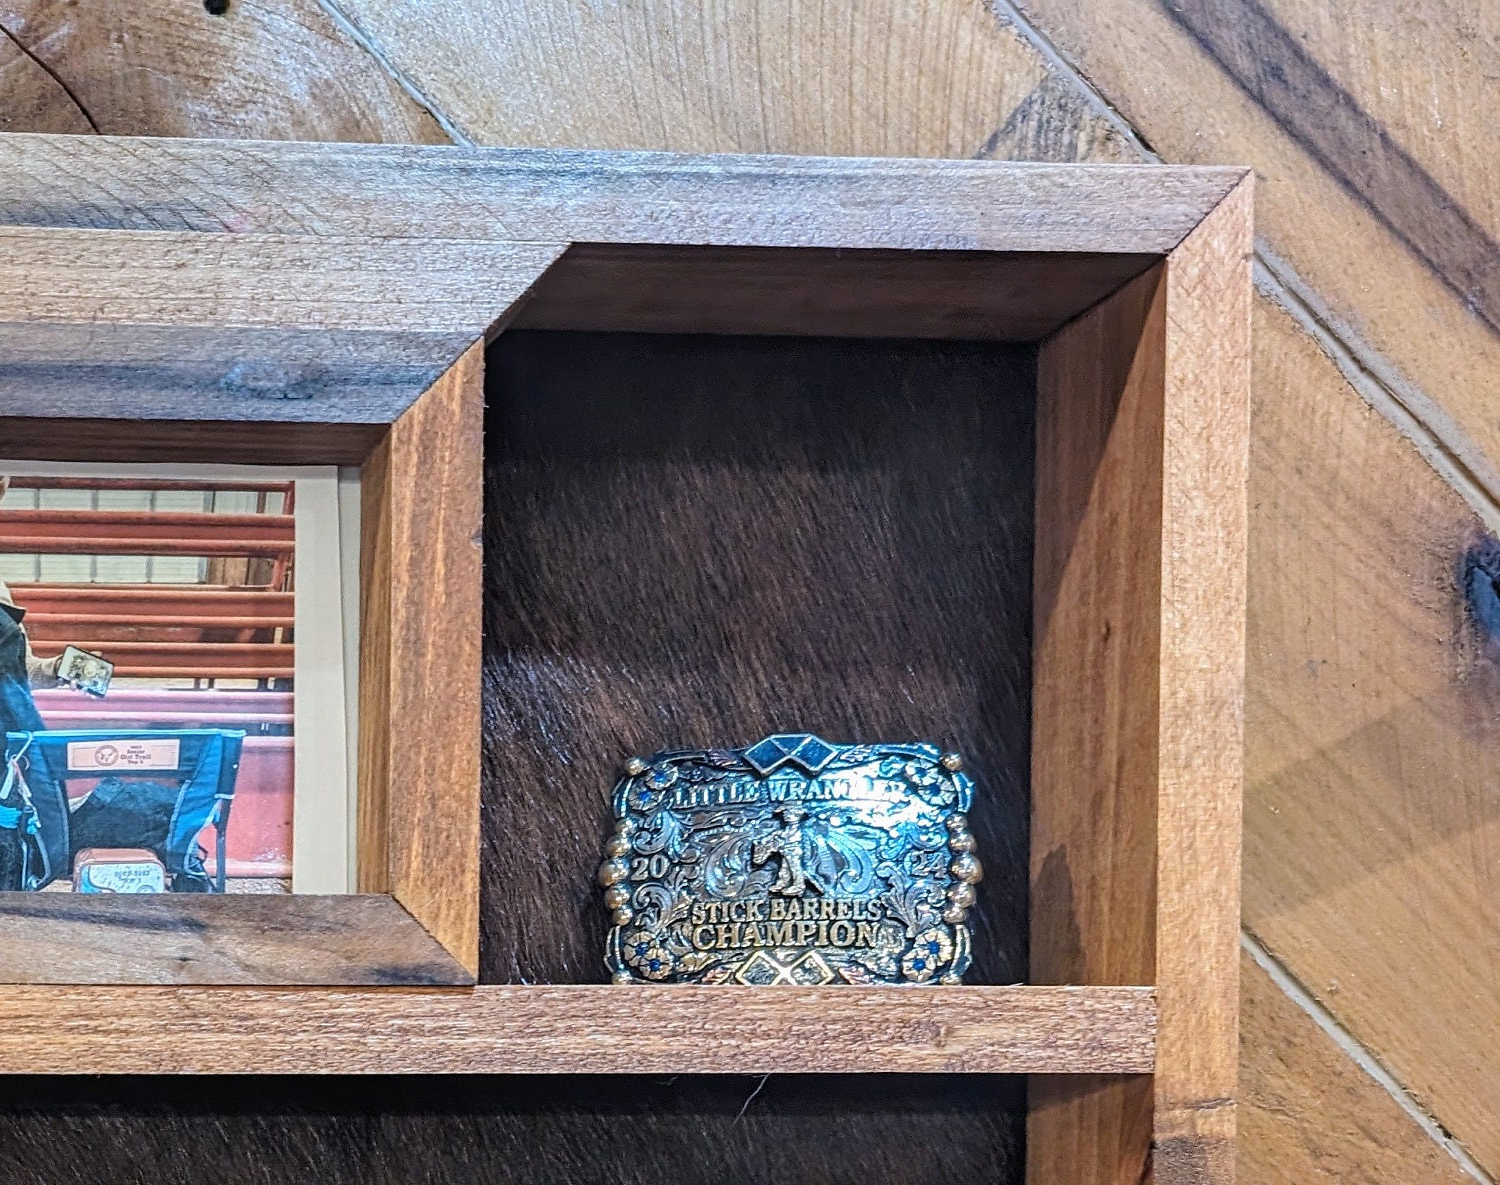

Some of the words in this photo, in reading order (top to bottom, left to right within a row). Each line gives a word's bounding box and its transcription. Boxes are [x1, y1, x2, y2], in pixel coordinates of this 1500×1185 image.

[674, 779, 759, 807] LITTLE
[632, 856, 668, 881] 20
[912, 854, 946, 878] 24
[692, 901, 763, 926] STICK
[770, 898, 882, 922] BARRELS
[692, 921, 883, 951] CHAMPION
